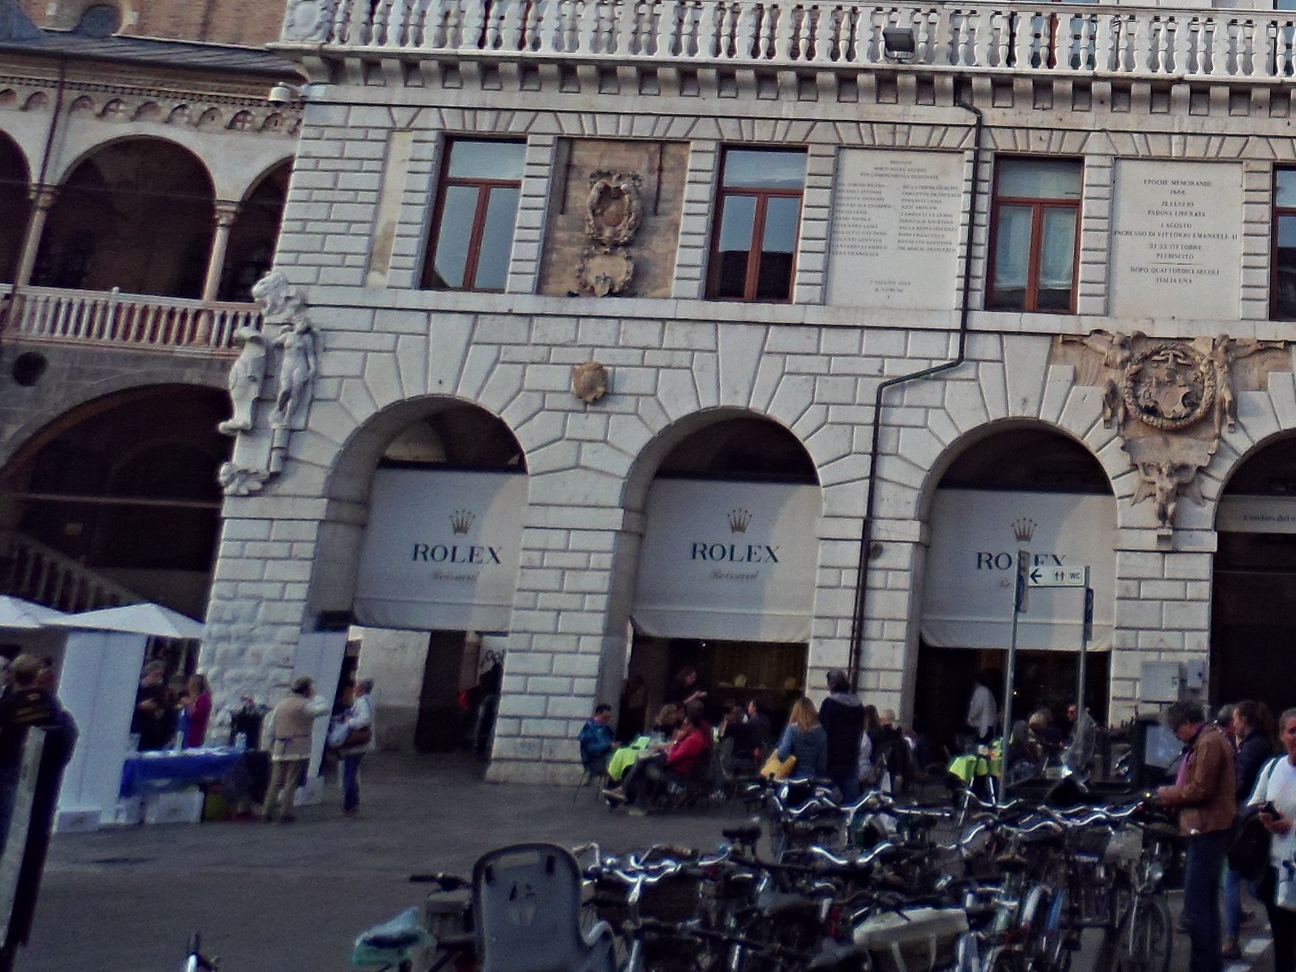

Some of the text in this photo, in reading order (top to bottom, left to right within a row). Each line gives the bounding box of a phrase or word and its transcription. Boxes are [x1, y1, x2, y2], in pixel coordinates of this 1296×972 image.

[412, 543, 502, 565] ROLEX
[691, 542, 780, 563] ROLEX
[976, 552, 1067, 570] ROEX
[1069, 572, 1081, 580] WC
